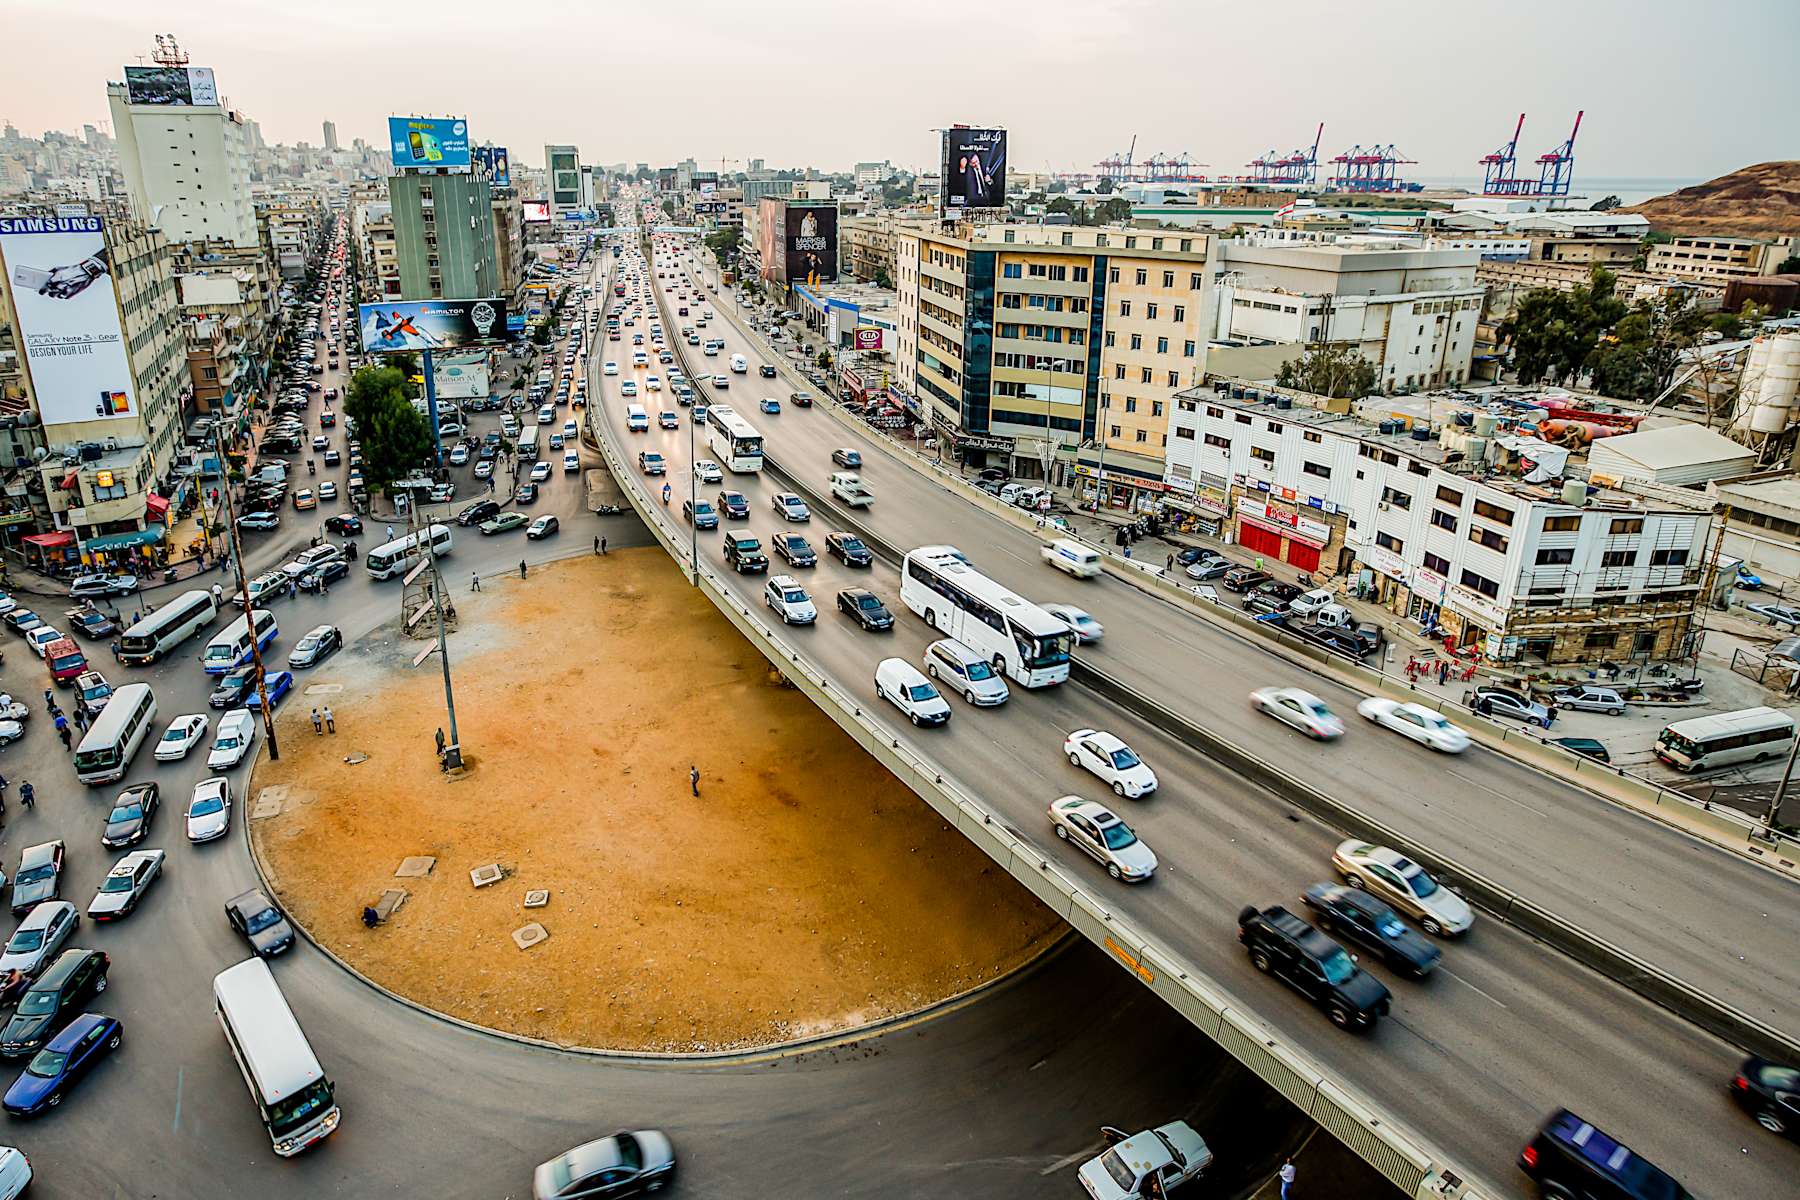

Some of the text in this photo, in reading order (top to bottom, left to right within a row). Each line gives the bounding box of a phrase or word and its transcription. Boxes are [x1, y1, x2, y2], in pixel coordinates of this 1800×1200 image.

[0, 218, 98, 232] SAMSUNG
[795, 243, 827, 251] SPENCER
[27, 337, 60, 345] GALAXY
[62, 335, 82, 343] Note
[29, 344, 93, 358] DESIGN YOUR LIFE
